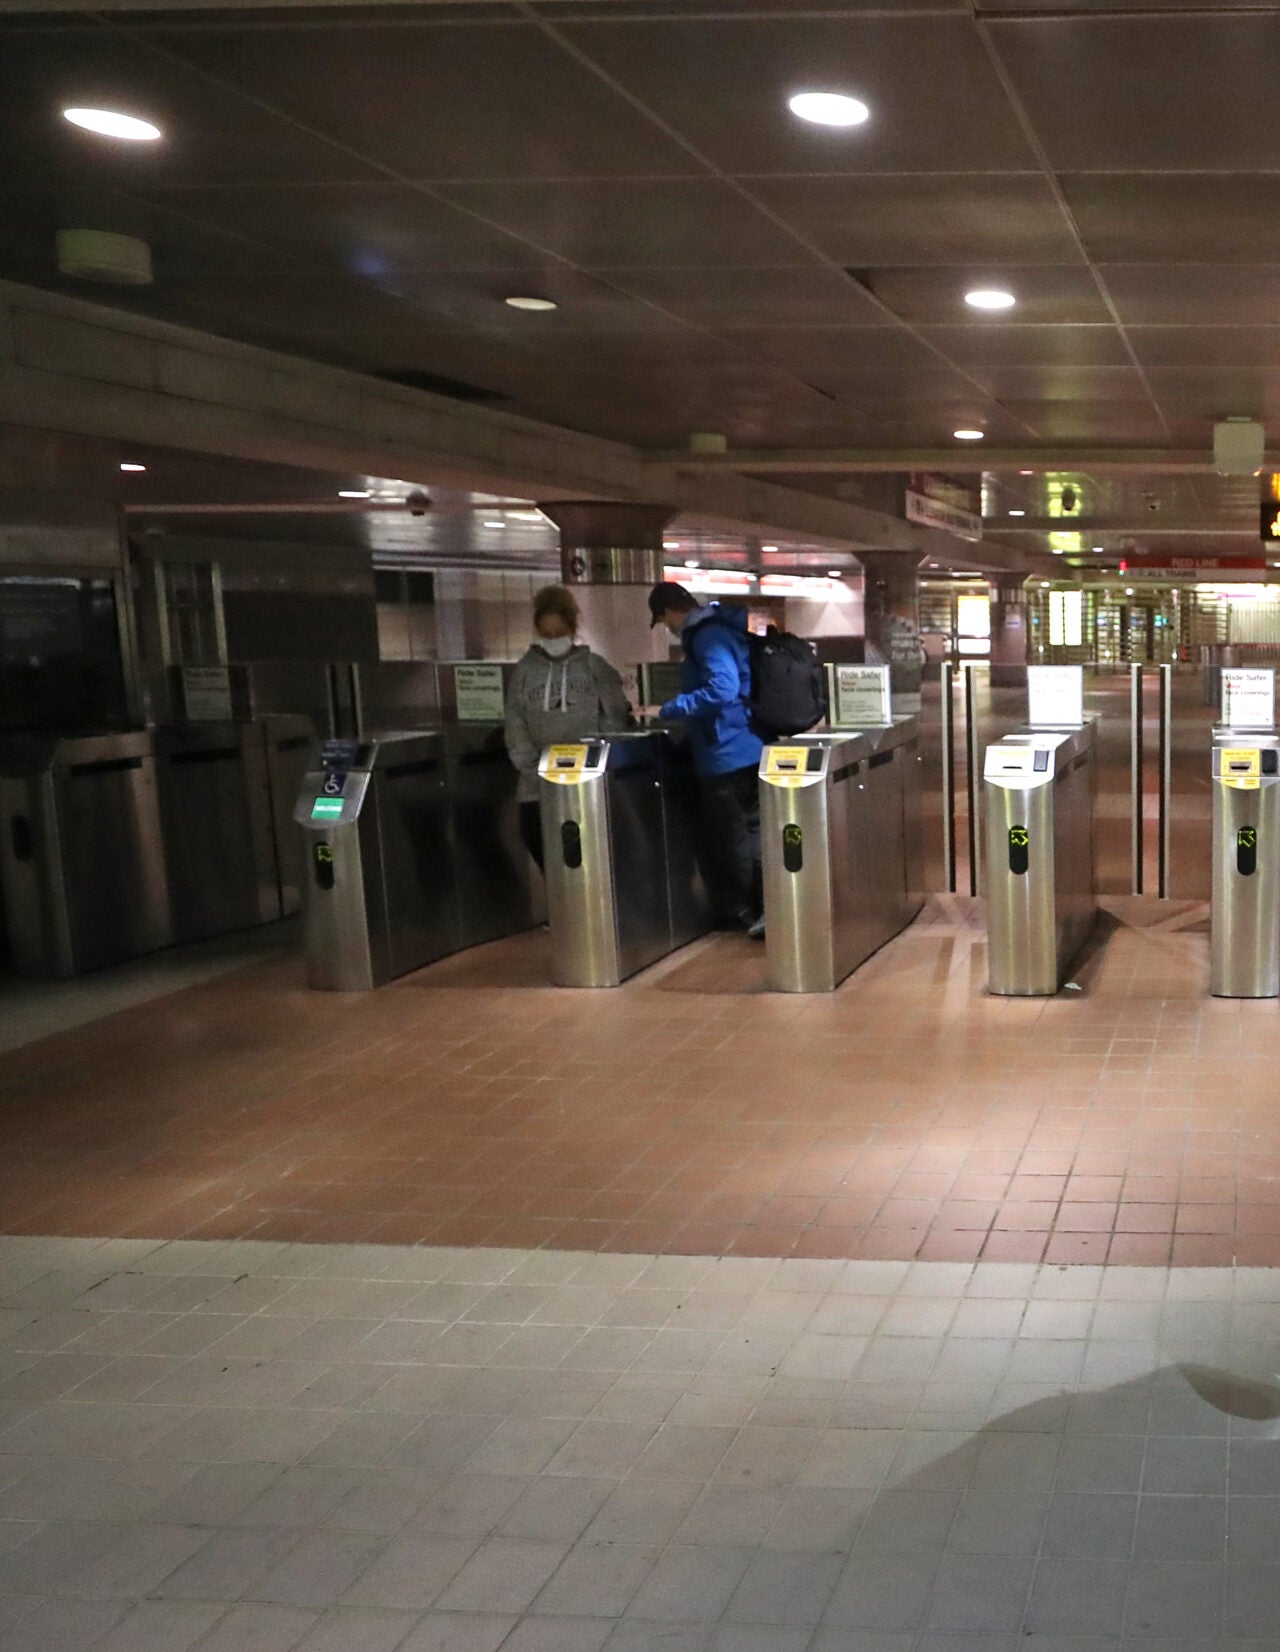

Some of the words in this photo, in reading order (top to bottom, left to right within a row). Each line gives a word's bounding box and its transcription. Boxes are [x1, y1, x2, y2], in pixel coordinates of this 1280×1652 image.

[1171, 558, 1194, 567] RED
[1196, 558, 1219, 567] LINE
[840, 670, 859, 679] Ride
